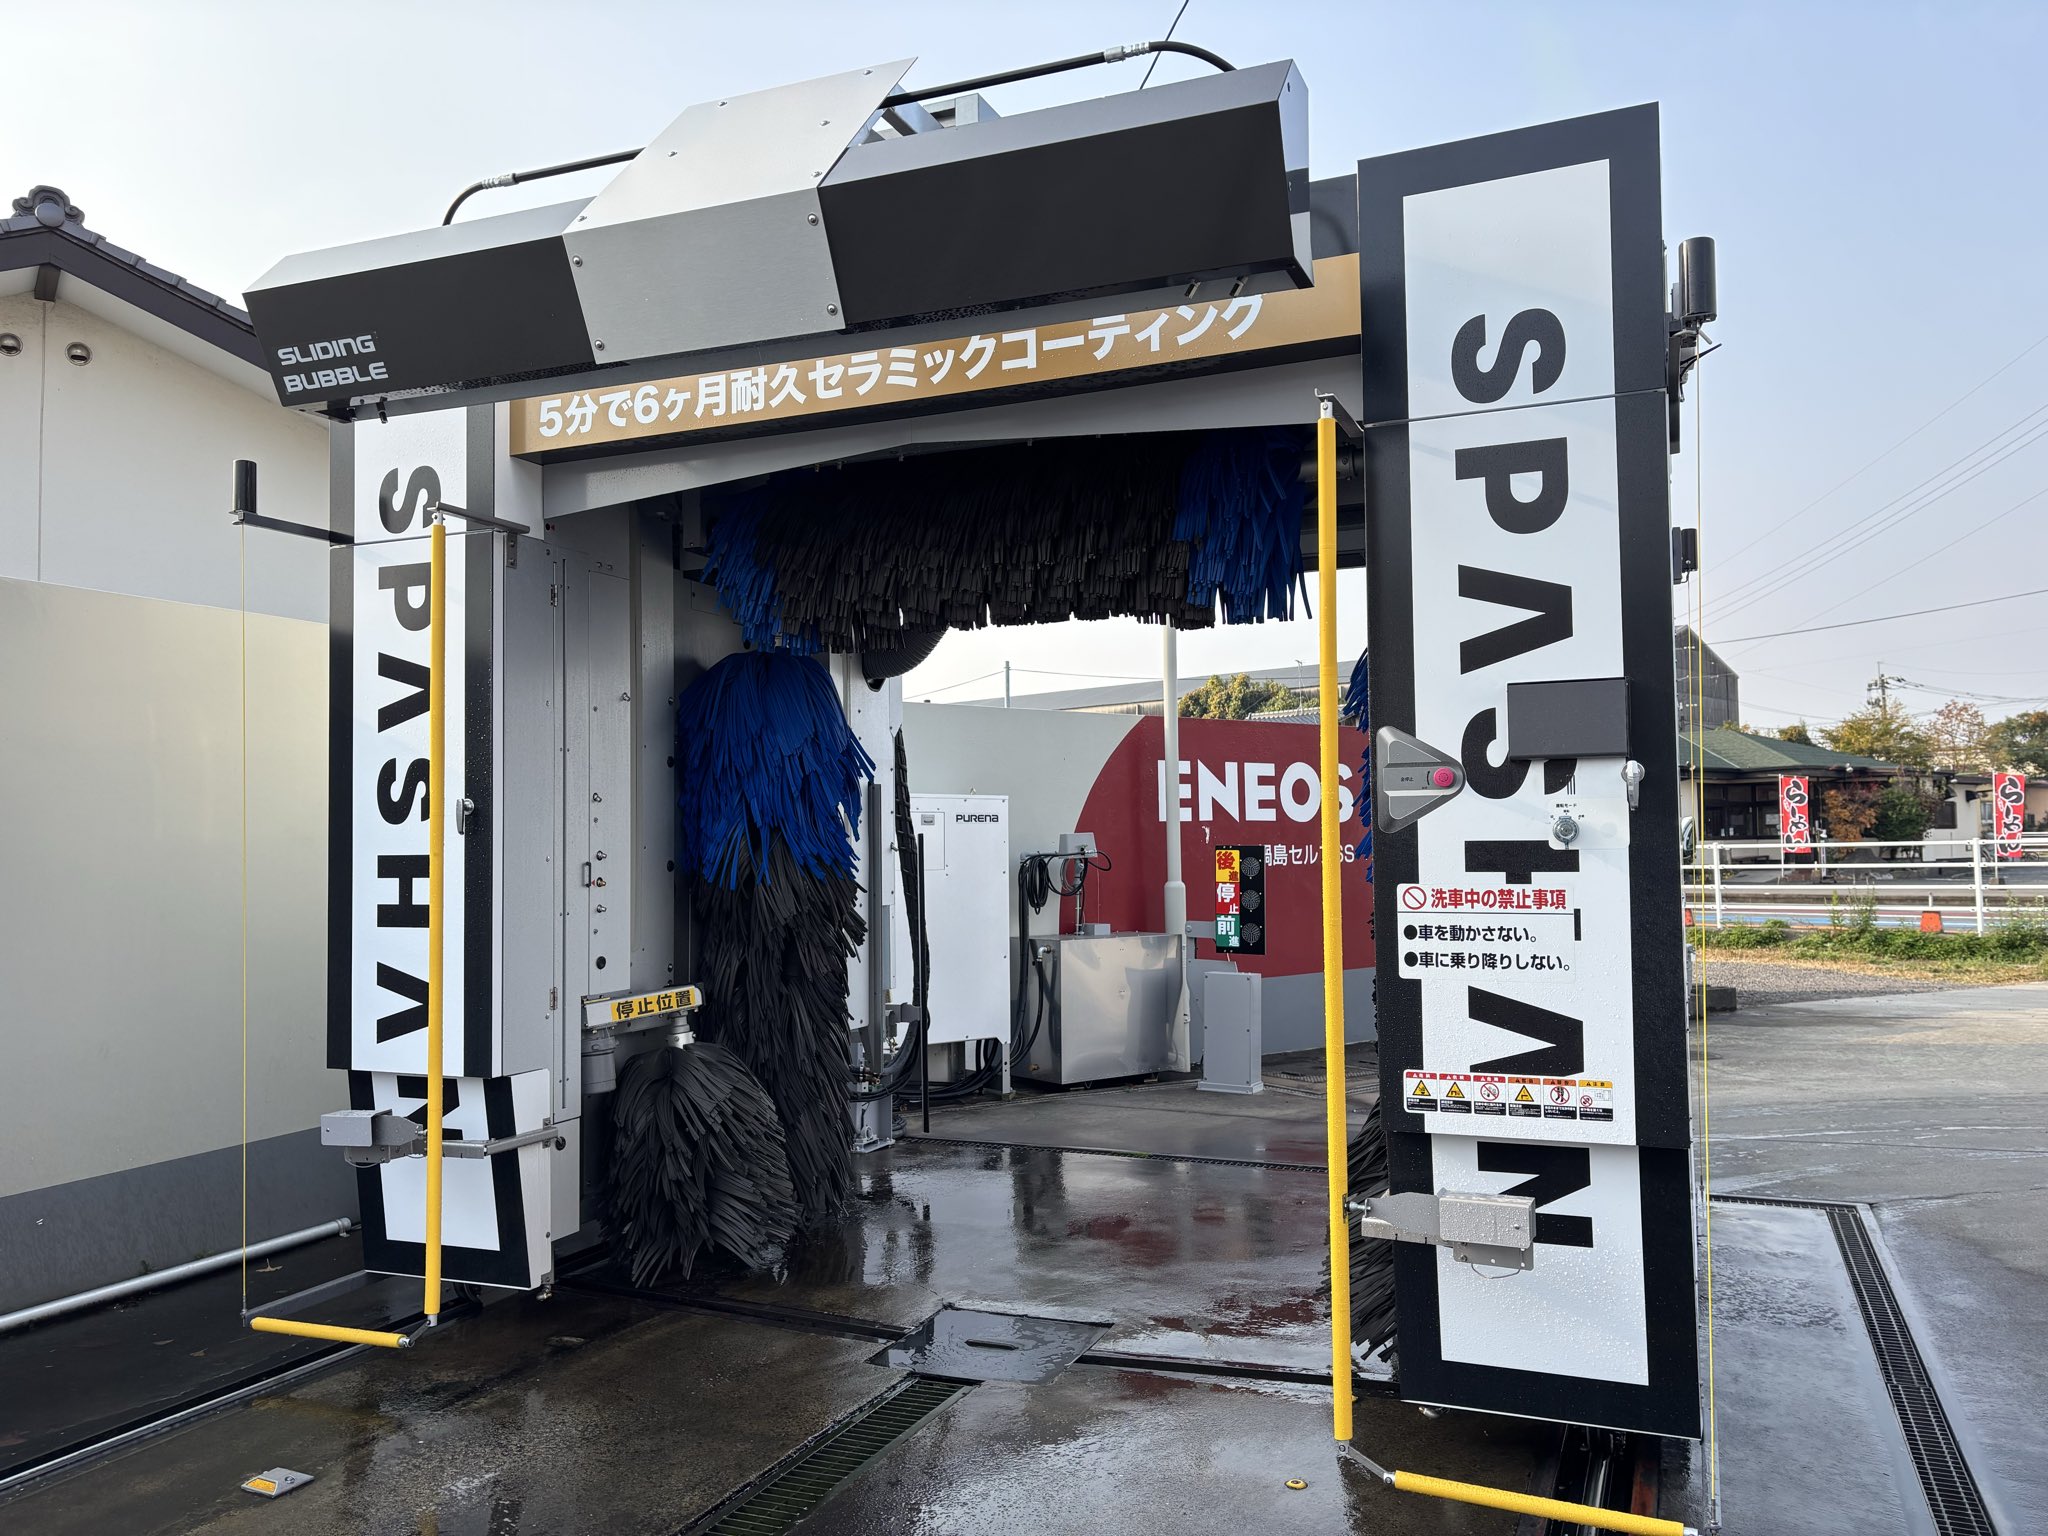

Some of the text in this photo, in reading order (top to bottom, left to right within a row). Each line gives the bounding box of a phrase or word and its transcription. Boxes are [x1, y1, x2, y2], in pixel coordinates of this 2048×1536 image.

[277, 334, 376, 365] SLIDING
[283, 362, 388, 392] BUBBLE
[1216, 851, 1239, 881] 後進
[1216, 882, 1240, 915] 停止
[1430, 888, 1567, 910] 洗車中の禁止事項
[1216, 915, 1240, 947] 前進
[616, 989, 692, 1019] 停止位置
